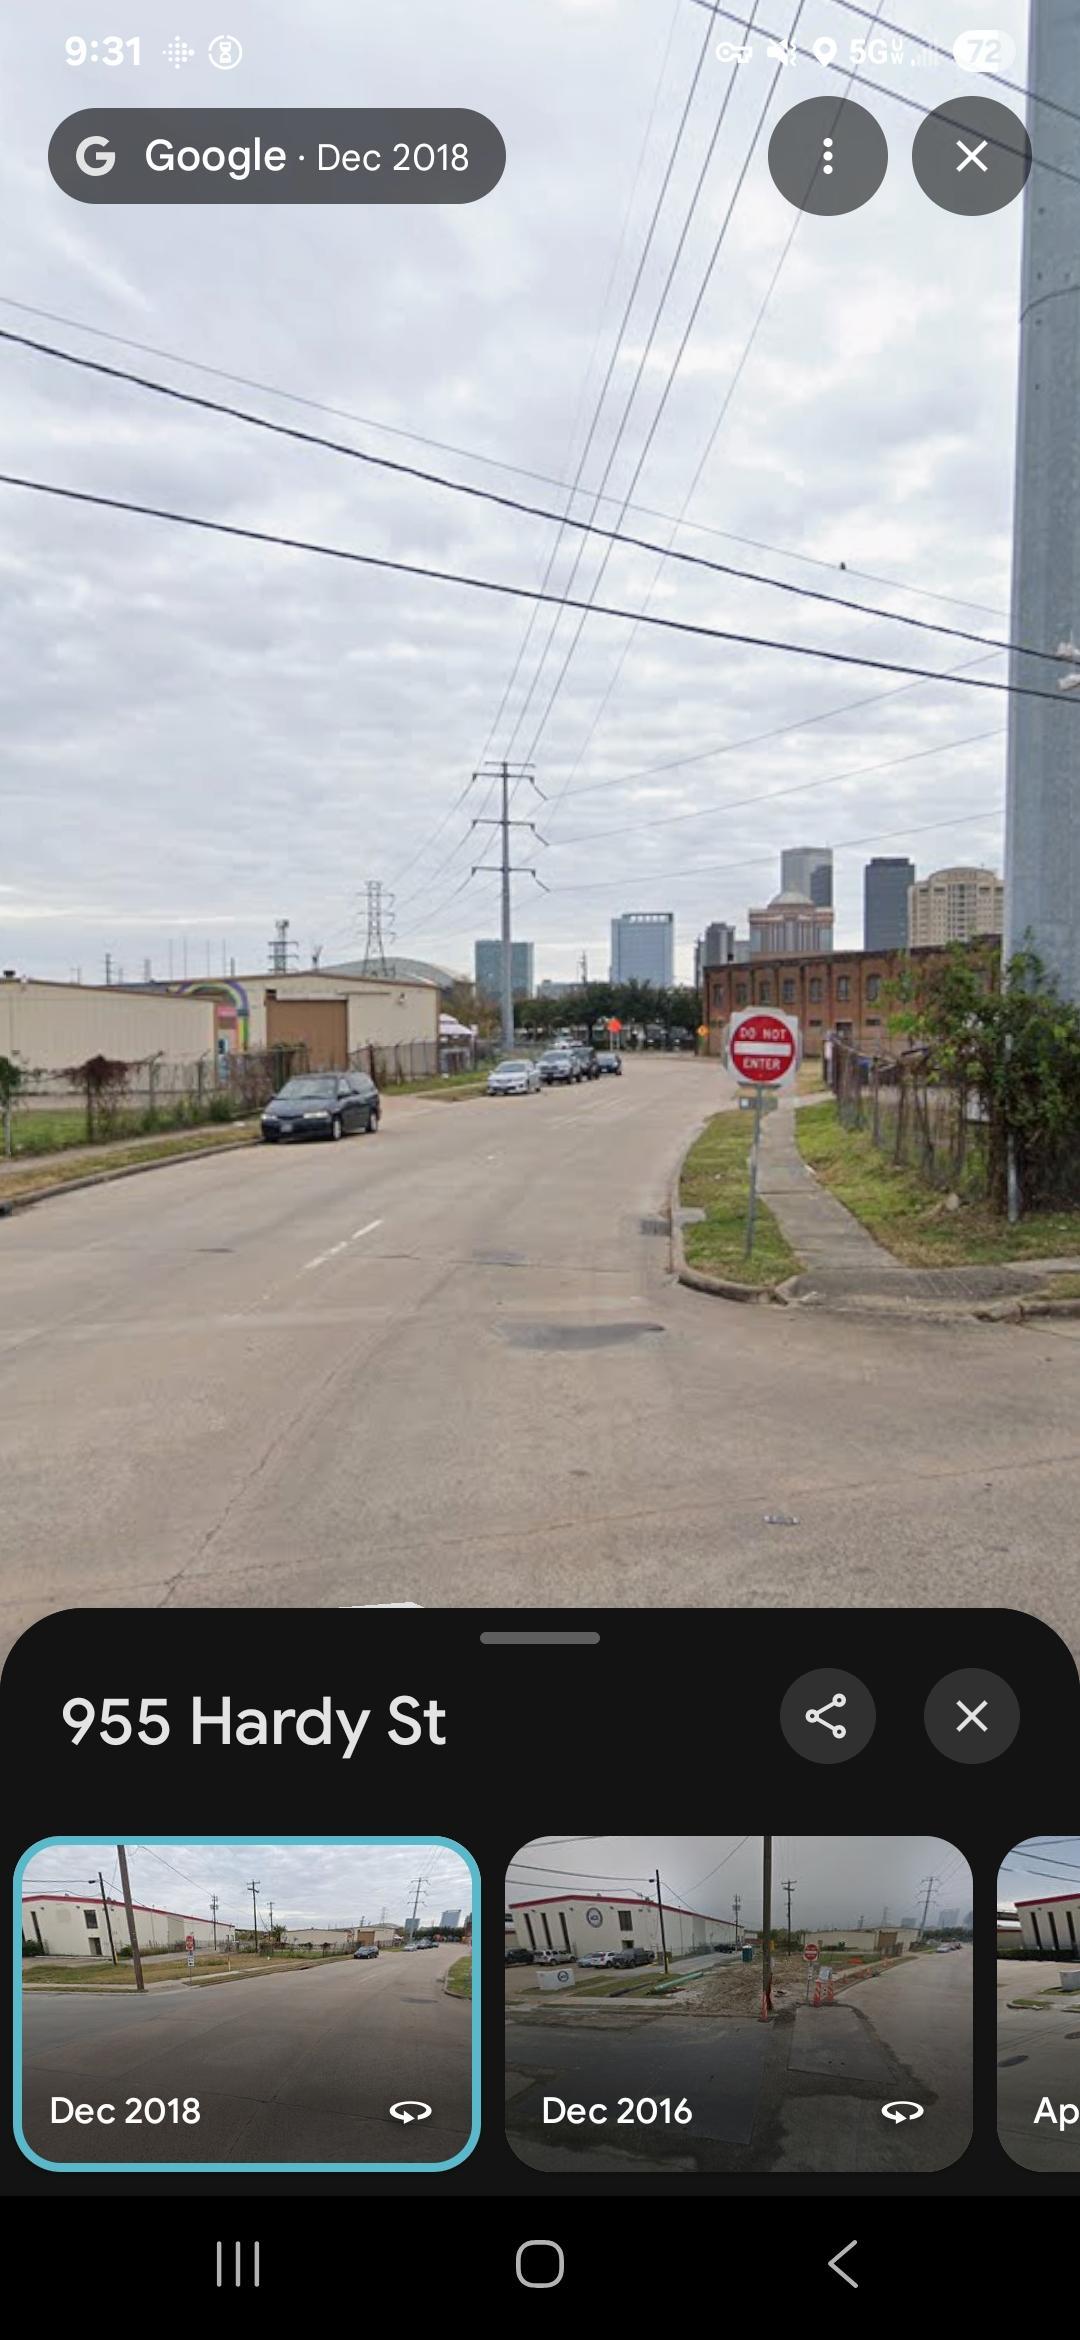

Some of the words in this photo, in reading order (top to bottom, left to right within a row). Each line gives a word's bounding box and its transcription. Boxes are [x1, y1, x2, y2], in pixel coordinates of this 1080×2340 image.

[740, 1027, 756, 1040] DO
[763, 1028, 787, 1040] NOT
[743, 1057, 781, 1071] ENTER
